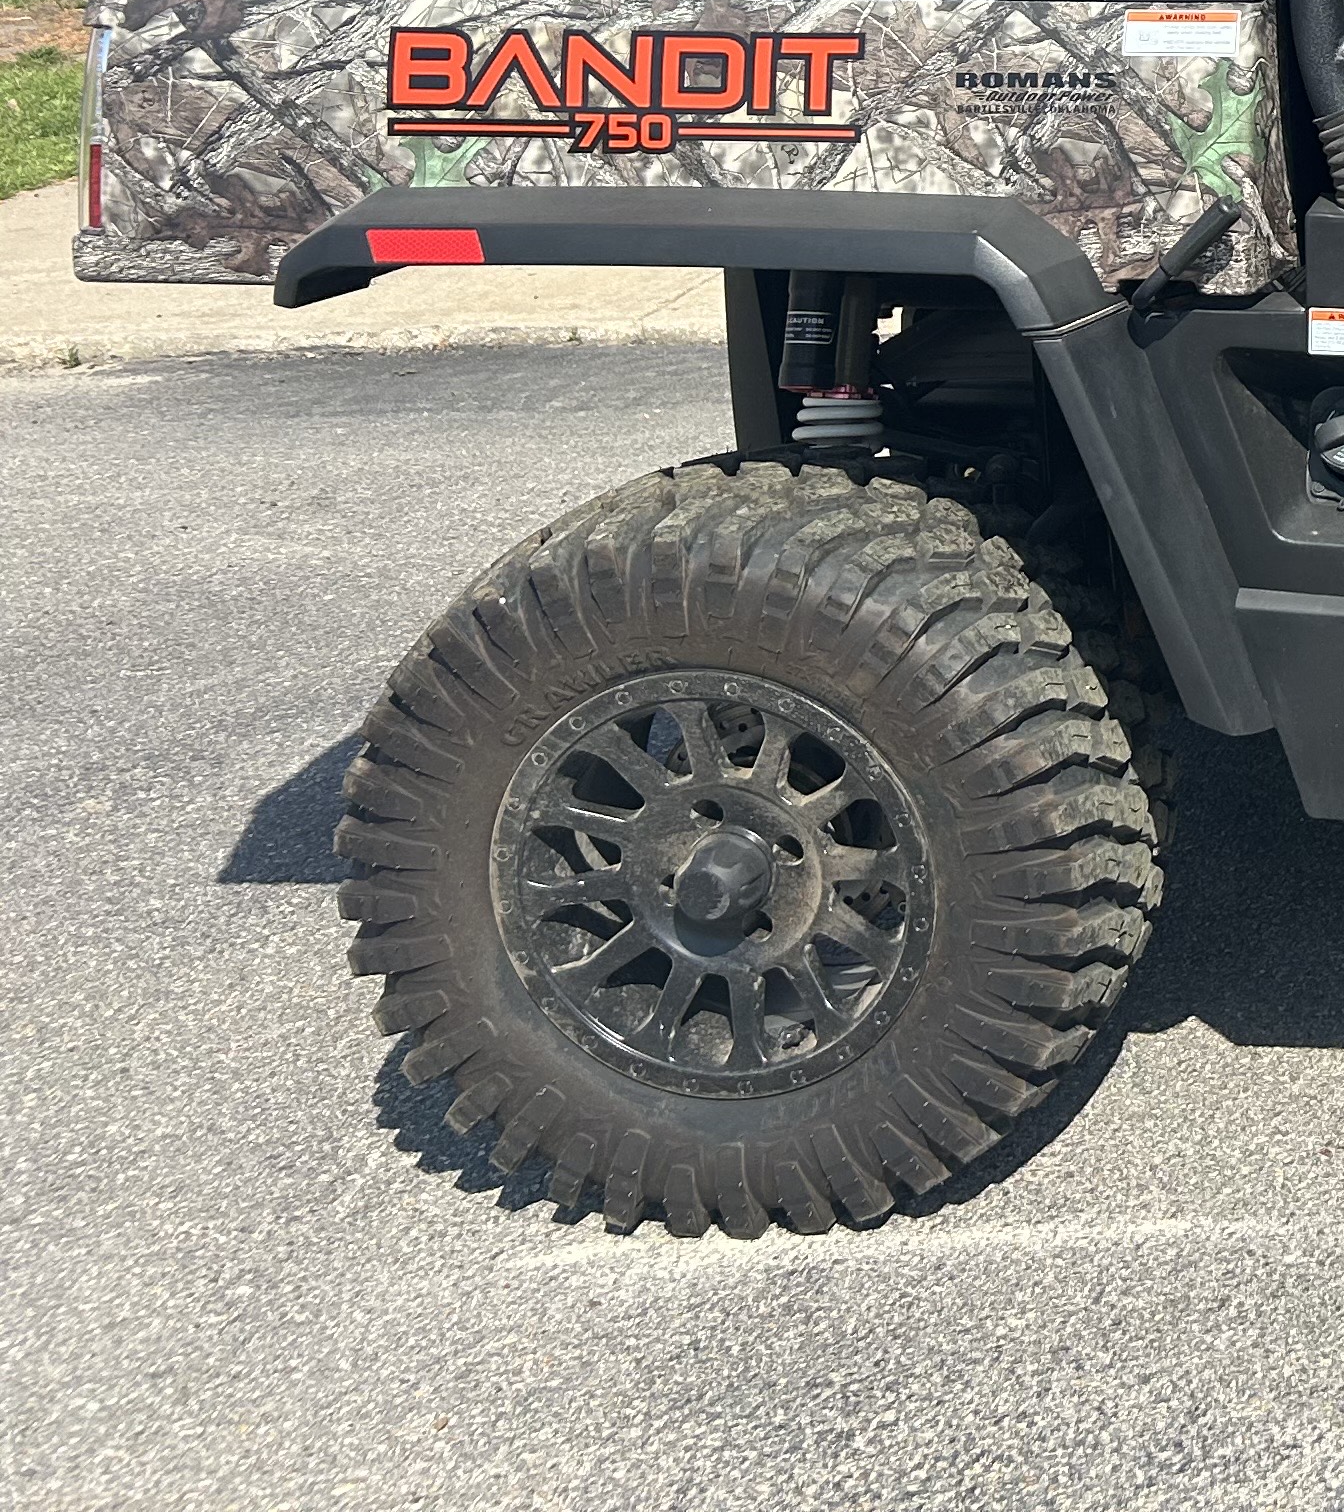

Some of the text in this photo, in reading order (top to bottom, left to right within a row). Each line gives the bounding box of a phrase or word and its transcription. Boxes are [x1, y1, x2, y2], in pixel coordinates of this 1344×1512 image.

[1165, 13, 1207, 21] WARNING
[389, 27, 864, 115] BANDIT
[956, 72, 1118, 88] ROMANS
[985, 91, 1115, 102] Outdoor Power
[567, 112, 676, 153] 750
